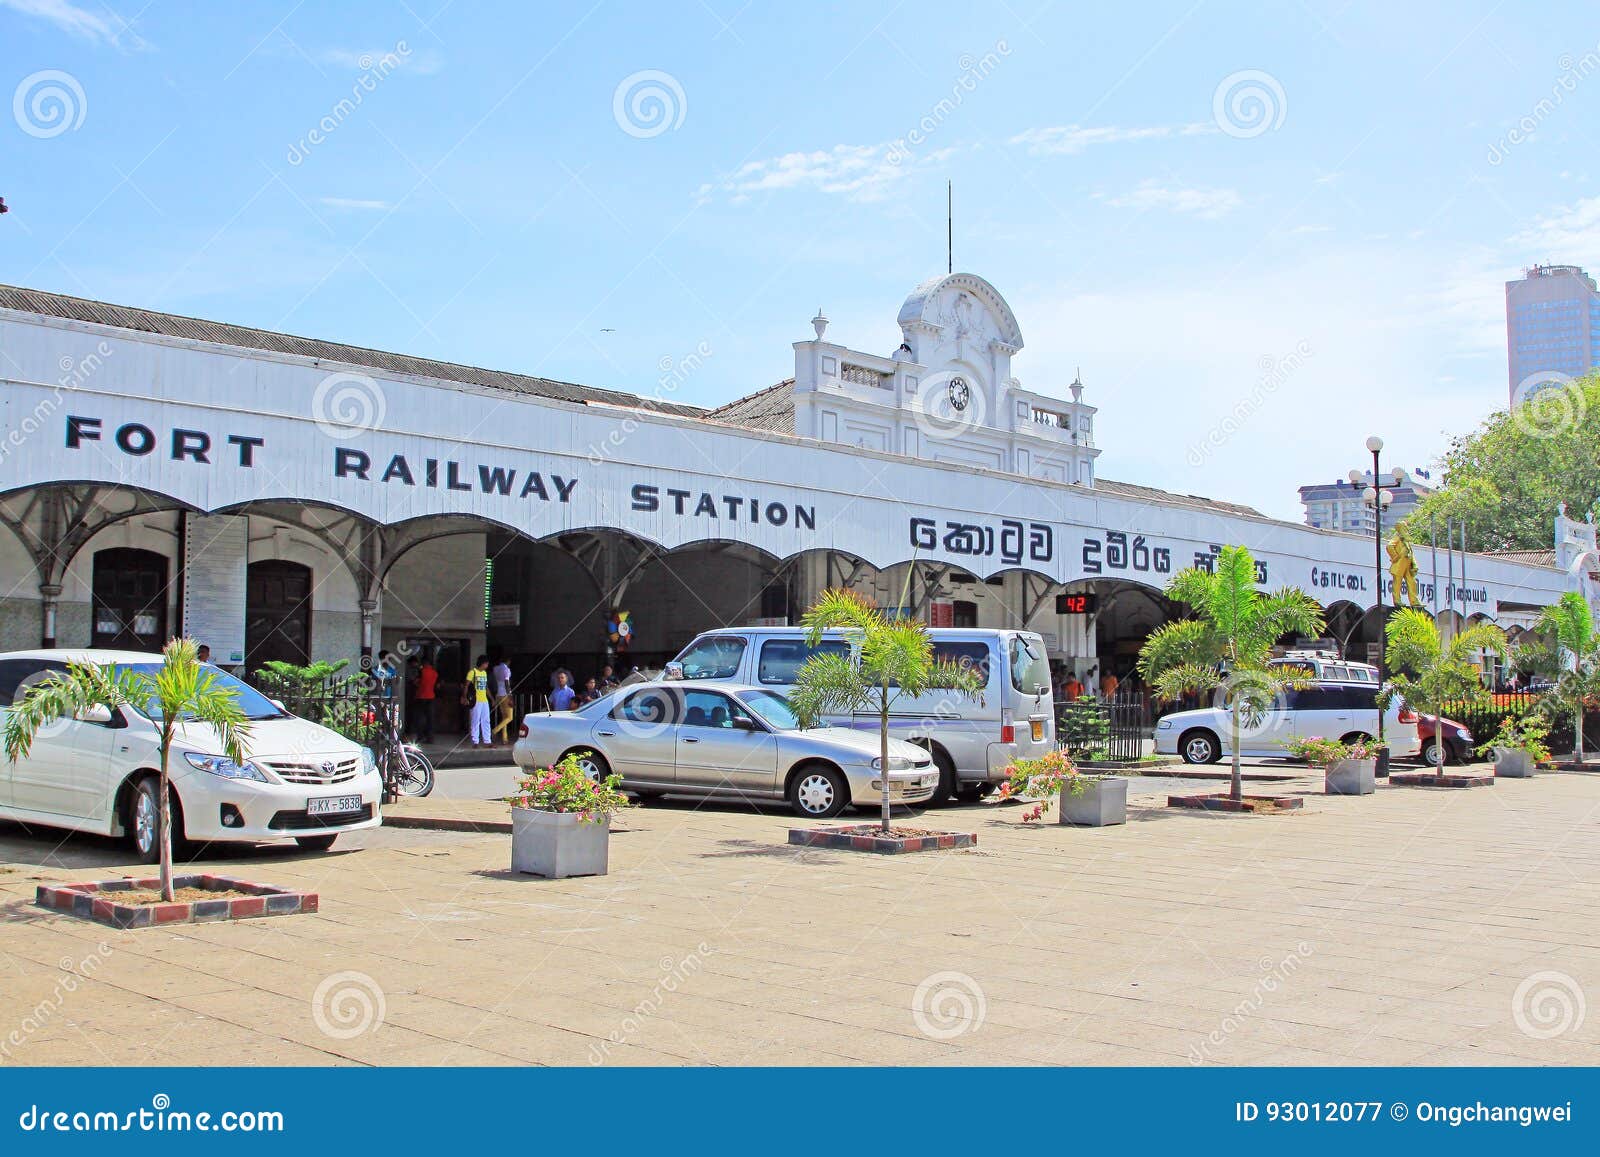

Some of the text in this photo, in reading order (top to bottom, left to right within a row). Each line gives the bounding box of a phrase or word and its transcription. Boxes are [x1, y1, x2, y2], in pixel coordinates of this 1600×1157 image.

[65, 415, 816, 531] FORT RAILWAY STATION
[910, 517, 1053, 565] කොටුව
[1311, 566, 1367, 592] கோட்டை
[1067, 596, 1085, 612] 42
